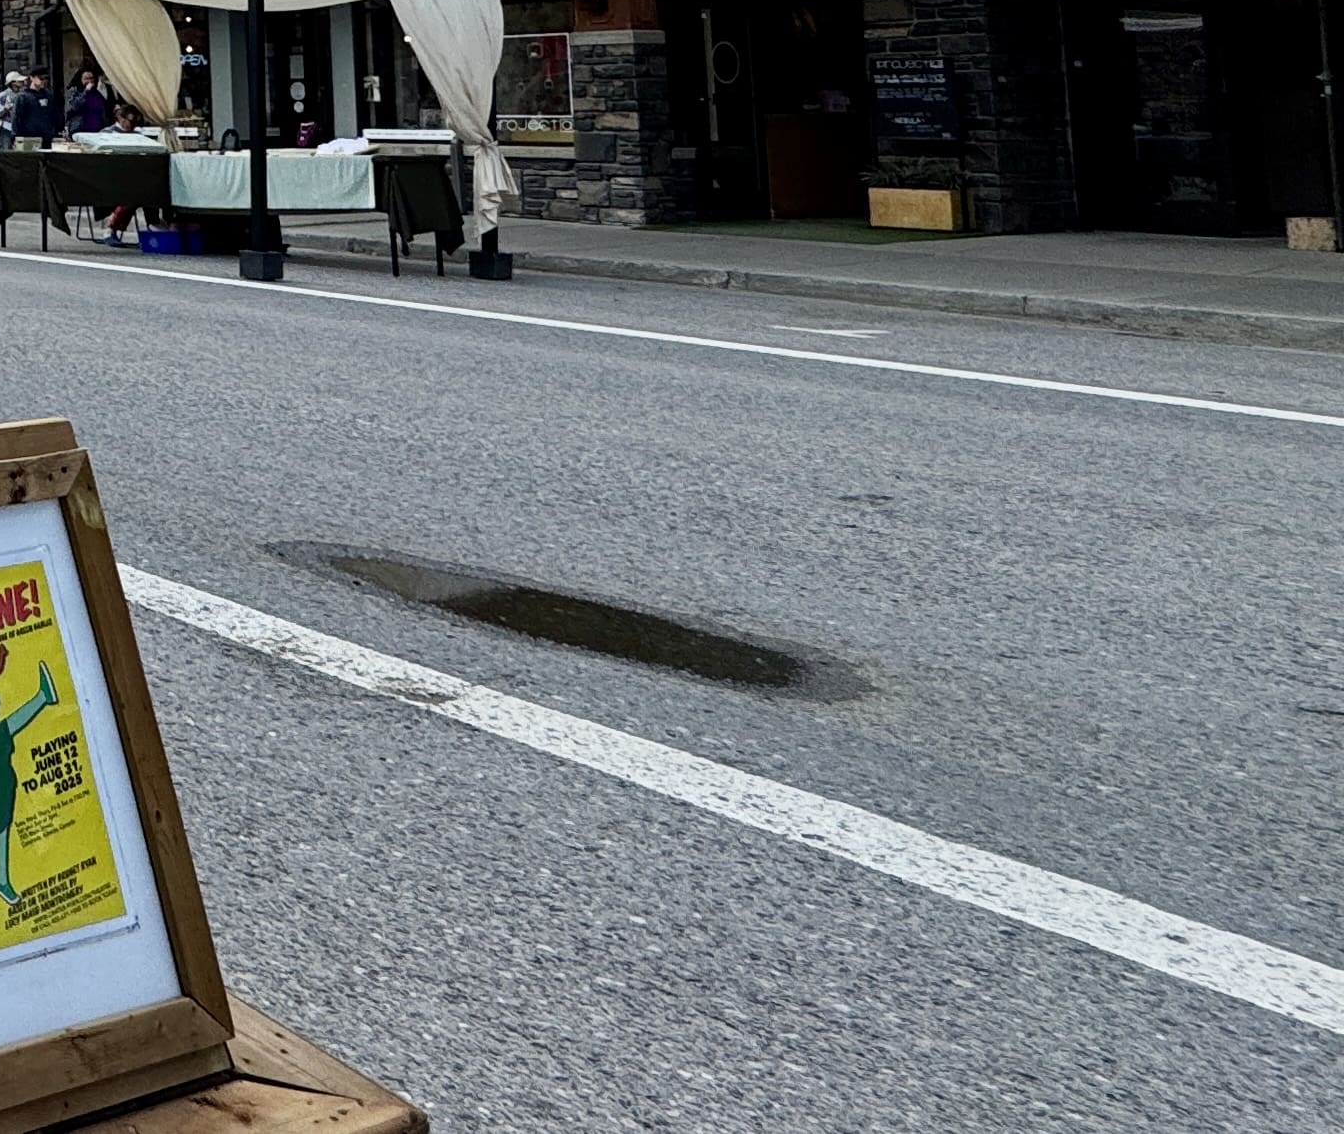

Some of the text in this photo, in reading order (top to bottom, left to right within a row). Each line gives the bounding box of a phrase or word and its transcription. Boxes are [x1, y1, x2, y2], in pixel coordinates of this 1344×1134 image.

[31, 731, 78, 761] PLAYING
[34, 745, 78, 775] JUNE 12
[22, 760, 83, 794] TO AUG 31,
[54, 773, 83, 795] 2025
